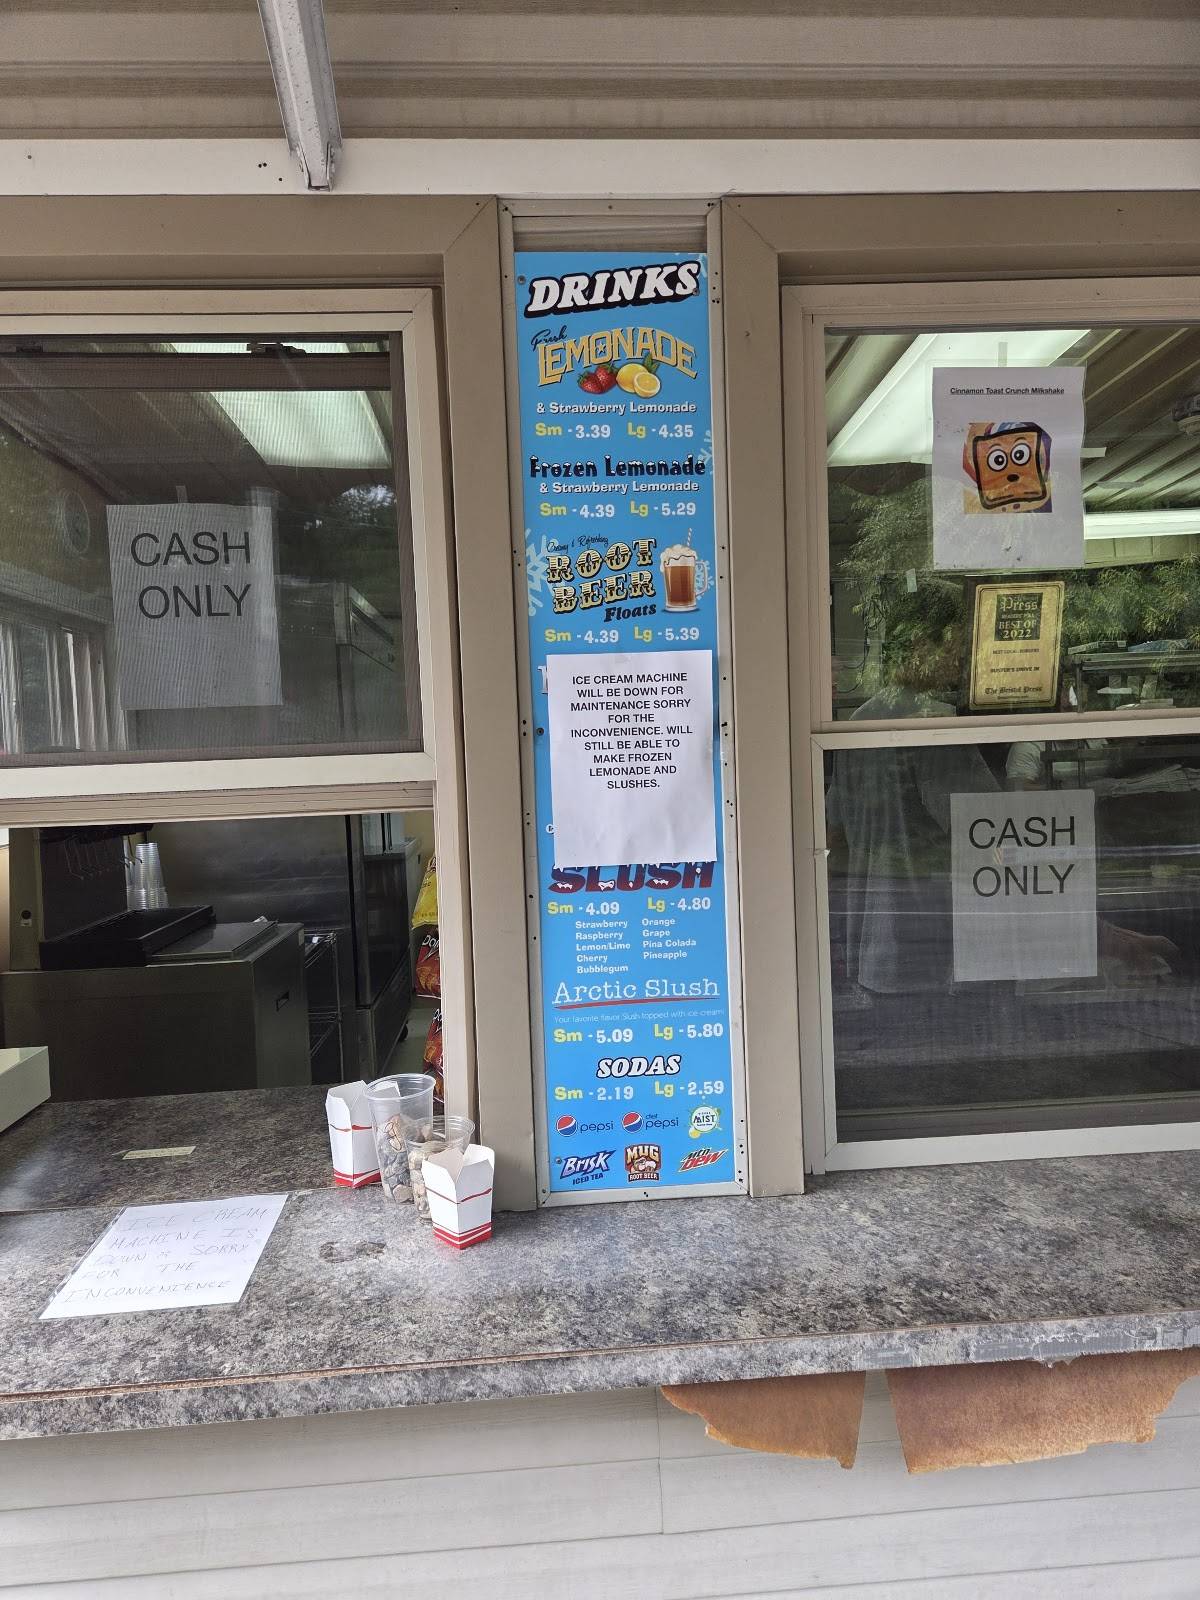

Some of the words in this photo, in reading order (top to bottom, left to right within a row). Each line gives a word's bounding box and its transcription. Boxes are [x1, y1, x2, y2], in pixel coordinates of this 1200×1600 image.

[524, 261, 700, 318] DRINKS
[538, 327, 698, 387] LEMONADE
[950, 387, 984, 395] Cinnamon
[986, 387, 1004, 395] Toast
[1005, 387, 1030, 395] Crunch
[1031, 387, 1065, 395] Milkshake
[536, 404, 545, 414] &
[550, 402, 625, 416] Strawberry
[629, 401, 697, 413] Lemonade
[535, 423, 563, 436] Sm
[627, 422, 646, 437] Lg
[530, 455, 598, 478] Frozen
[604, 454, 706, 477] Lemonade
[539, 484, 549, 494] &
[552, 482, 628, 495] Strawberry
[632, 480, 700, 492] Lemonade
[540, 502, 567, 516] Sm
[630, 501, 649, 517] Lg
[131, 531, 251, 567] CASH
[546, 538, 657, 584] ROOT
[552, 570, 656, 614] BEER
[138, 584, 251, 619] ONLY
[603, 604, 657, 622] Floats
[544, 629, 571, 642] Sm
[634, 626, 652, 642] Lg
[1003, 629, 1031, 639] 2022
[572, 675, 591, 685] ICE
[593, 674, 633, 684] CREAM
[636, 673, 688, 683] MACHINE
[577, 688, 603, 698] WILL
[606, 688, 621, 697] BE
[624, 687, 658, 696] DOWN
[661, 686, 684, 695] FOR
[570, 700, 650, 711] MAINTENANCE
[653, 699, 691, 709] SORRY
[608, 714, 630, 723] FOR
[633, 713, 655, 722] THE
[571, 726, 664, 738] INCONVENIENCE.
[666, 725, 693, 735] WILL
[584, 741, 614, 751] STILL
[617, 740, 631, 749] BE
[634, 740, 662, 749] ABLE
[665, 739, 680, 748] TO
[593, 754, 625, 764] MAKE
[628, 752, 672, 763] FROZEN
[589, 766, 651, 777] LEMONADE
[653, 765, 677, 775] AND
[607, 779, 660, 790] SLUSHES.
[968, 816, 1076, 849] CASH
[548, 861, 715, 894] SLUSH
[972, 863, 1075, 897] ONLY
[547, 902, 573, 914] Sm
[647, 897, 665, 912] Lg
[575, 920, 628, 930] Strawberry
[642, 918, 675, 928] Orange
[575, 931, 623, 941] Raspberry
[642, 929, 671, 939] Grape
[576, 942, 631, 951] Lemon/Lime
[643, 940, 662, 949] Pina
[665, 939, 697, 948] Colada
[576, 954, 608, 964] Cherry
[643, 951, 687, 960] Pineapple
[576, 965, 629, 975] Bubblegum
[552, 980, 637, 1005] Arctic
[644, 978, 720, 998] Slush
[554, 1015, 571, 1024] Your
[554, 1029, 582, 1042] Sm
[654, 1024, 673, 1040] Lg
[596, 1054, 682, 1079] SODAS
[554, 1087, 583, 1100] Sm
[654, 1081, 674, 1097] Lg
[645, 1117, 679, 1130] pepsi
[693, 1114, 716, 1123] MIST
[580, 1120, 614, 1135] pepsi
[626, 1145, 660, 1164] MUG
[572, 1175, 589, 1186] ICED
[591, 1172, 604, 1181] TEA
[158, 1261, 200, 1273] THE
